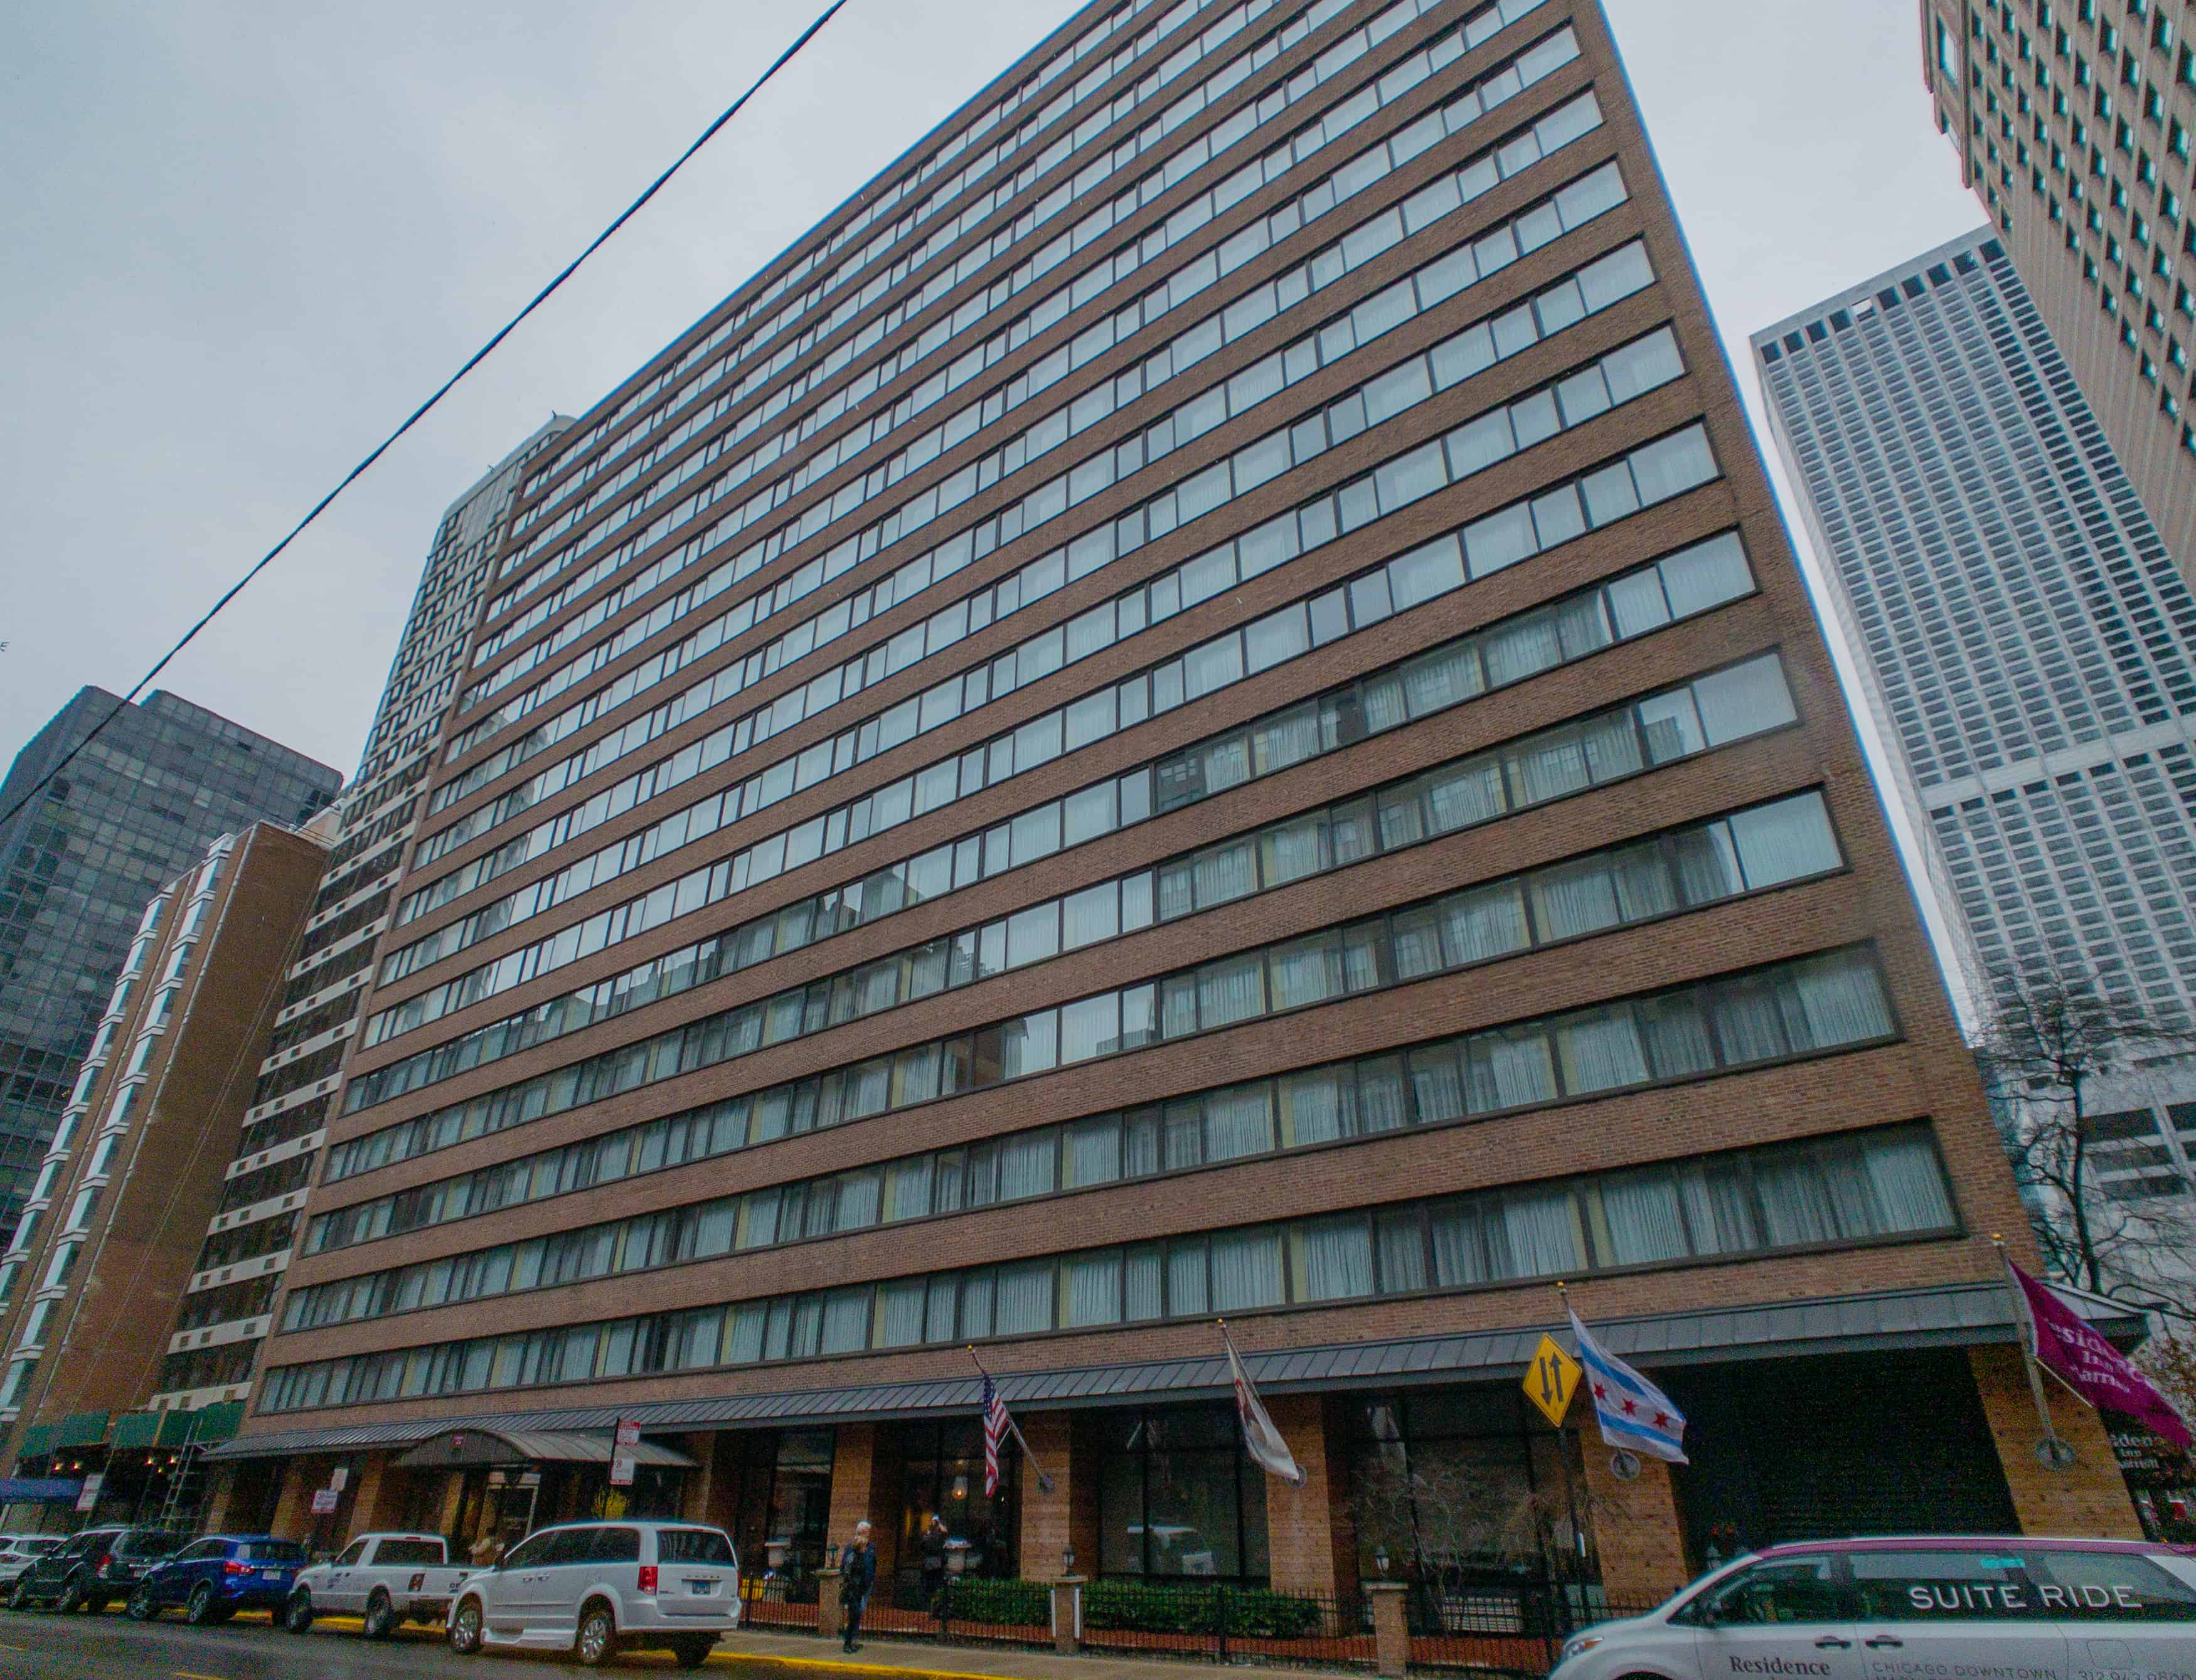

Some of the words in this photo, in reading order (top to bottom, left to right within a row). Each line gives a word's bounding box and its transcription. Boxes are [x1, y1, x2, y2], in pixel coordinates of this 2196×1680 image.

[1909, 1585, 2027, 1610] SUITE
[2039, 1585, 2143, 1608] RIDE
[1729, 1656, 1831, 1676] Residence
[1872, 1662, 1948, 1676] CHICAGO
[1954, 1664, 2057, 1680] DOWNTOWN
